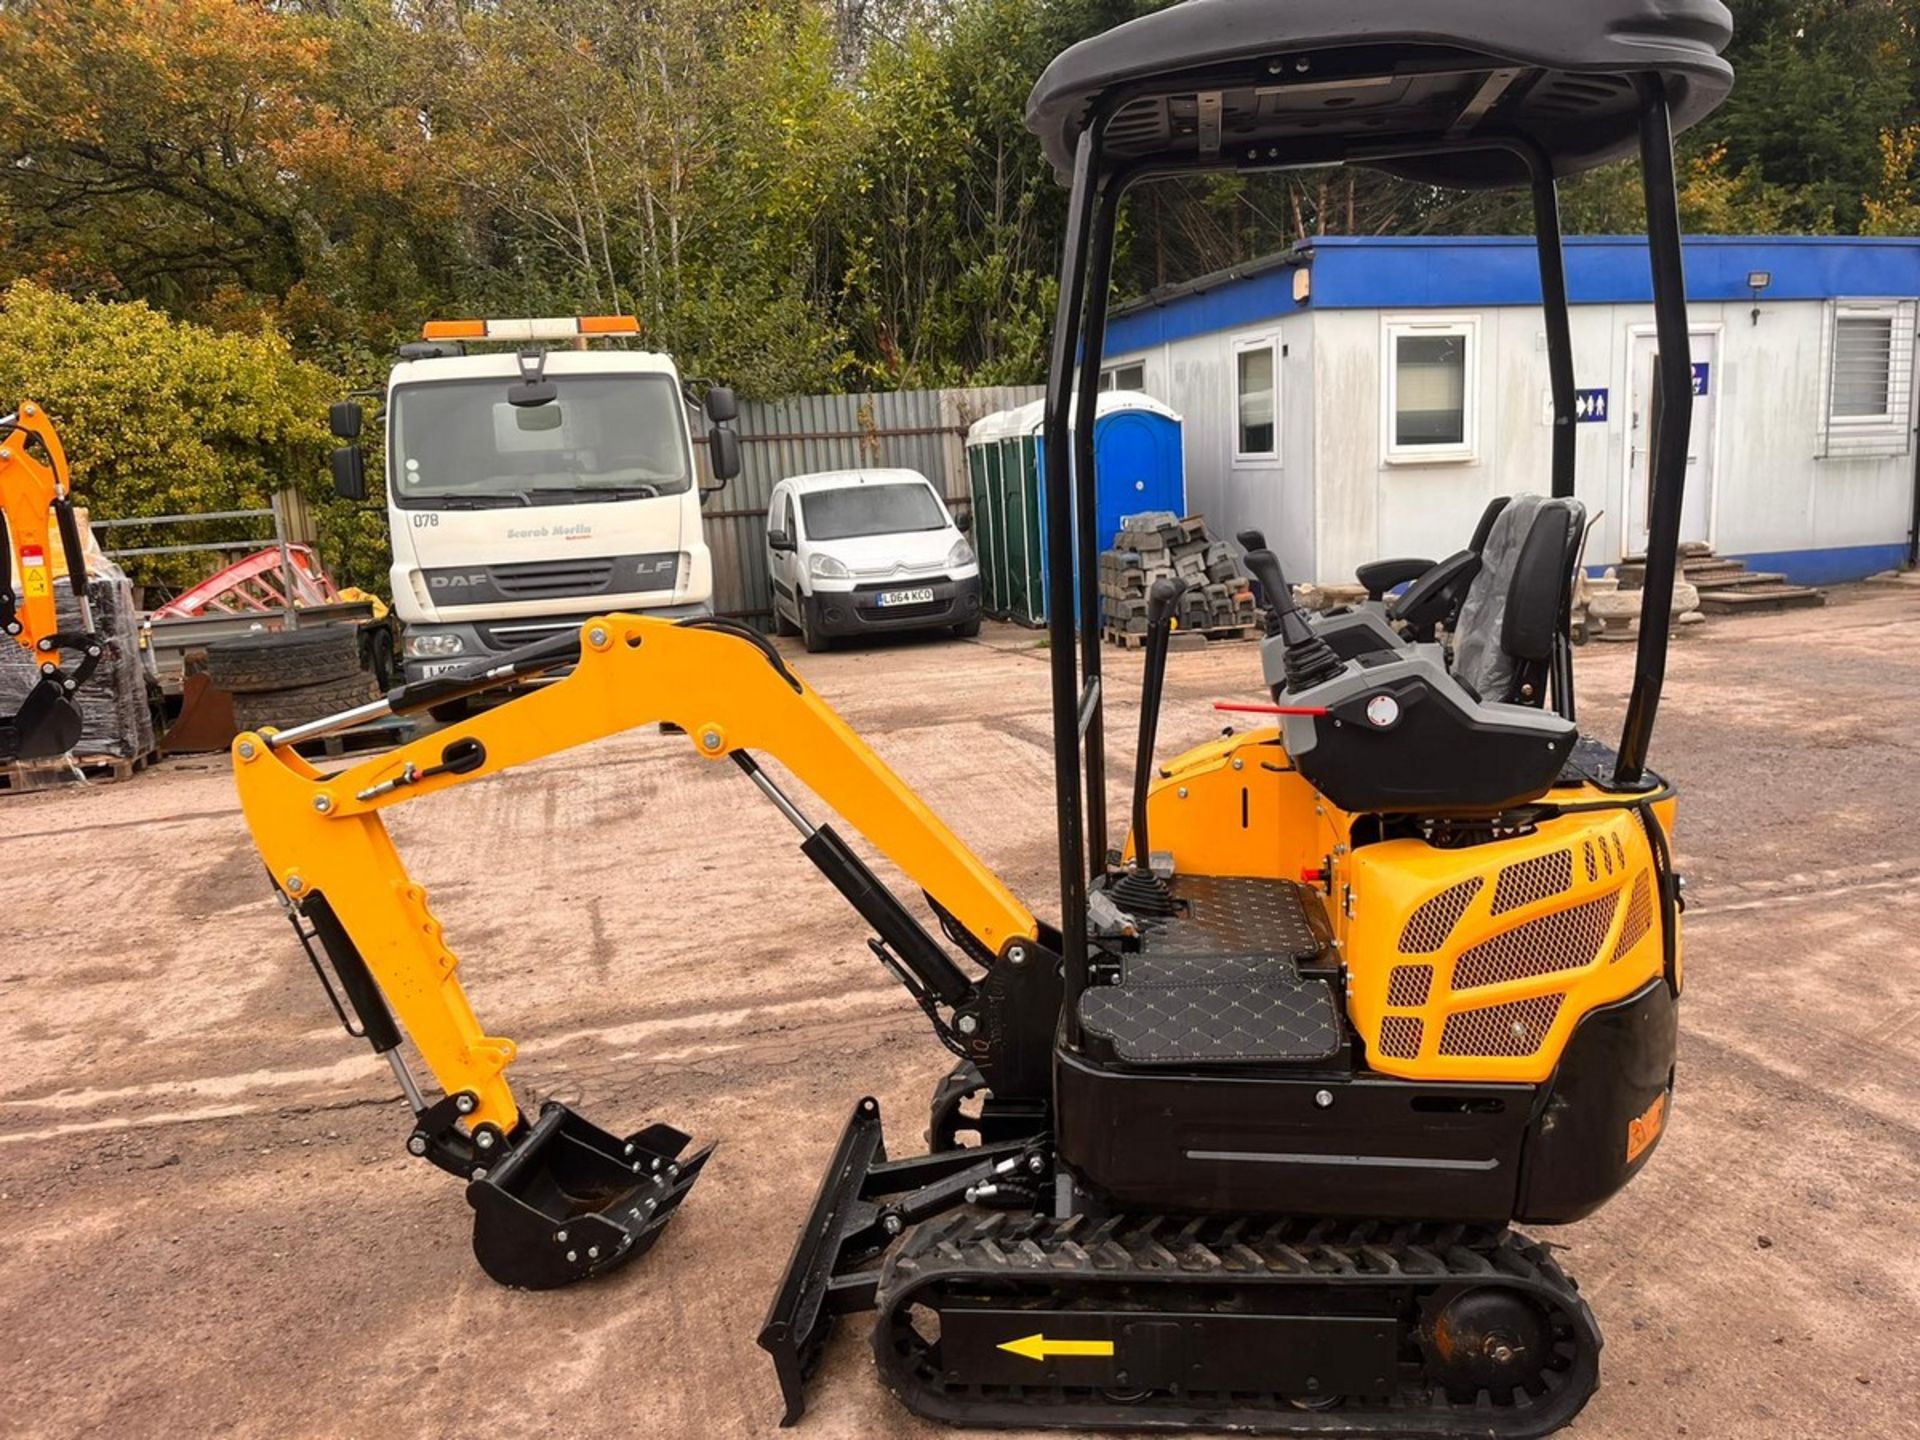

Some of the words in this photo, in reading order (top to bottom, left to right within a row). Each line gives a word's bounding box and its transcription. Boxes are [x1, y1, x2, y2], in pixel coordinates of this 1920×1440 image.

[413, 513, 439, 528] 078
[636, 561, 673, 574] LF
[430, 574, 487, 588] DAF
